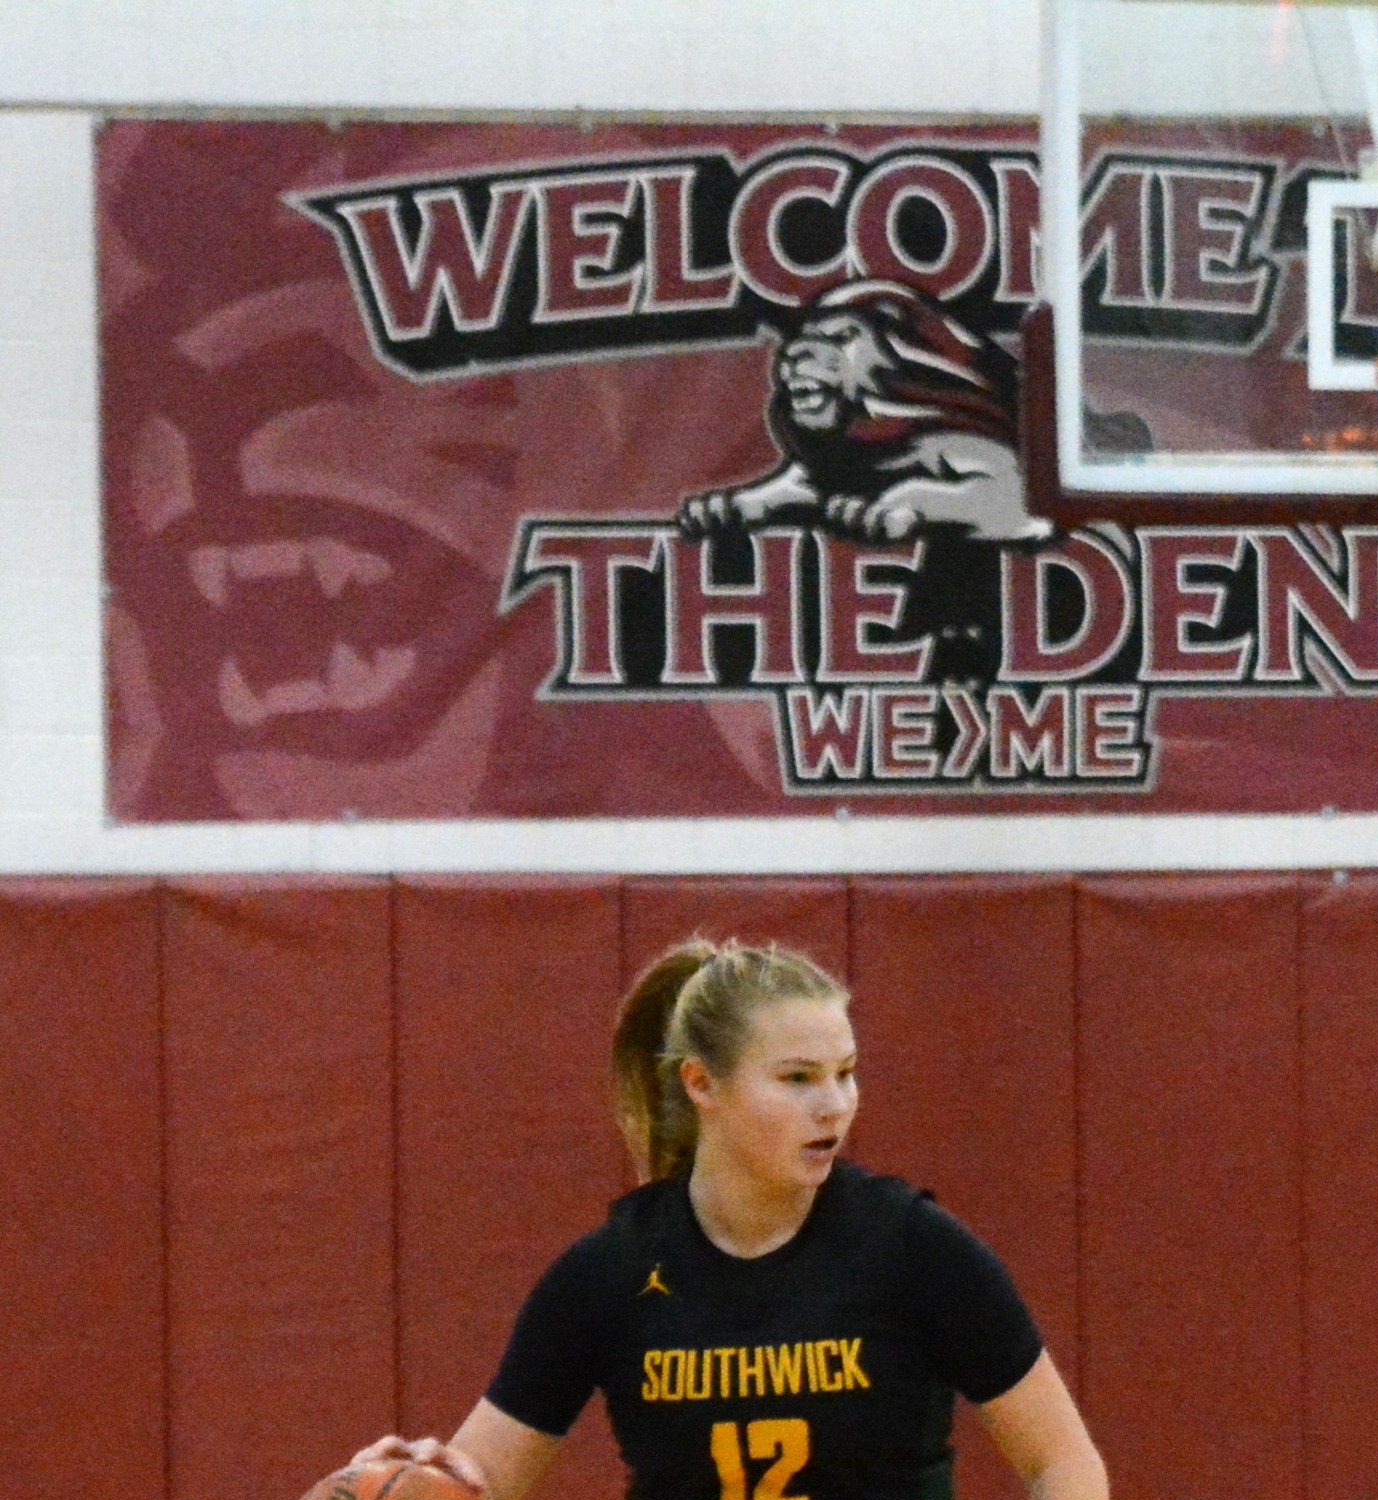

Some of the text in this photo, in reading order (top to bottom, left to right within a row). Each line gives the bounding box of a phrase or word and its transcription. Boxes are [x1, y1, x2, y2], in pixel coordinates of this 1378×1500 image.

[336, 152, 1271, 341] WELCOME
[525, 530, 936, 687] THE
[640, 1336, 872, 1402] SOUTHWICK
